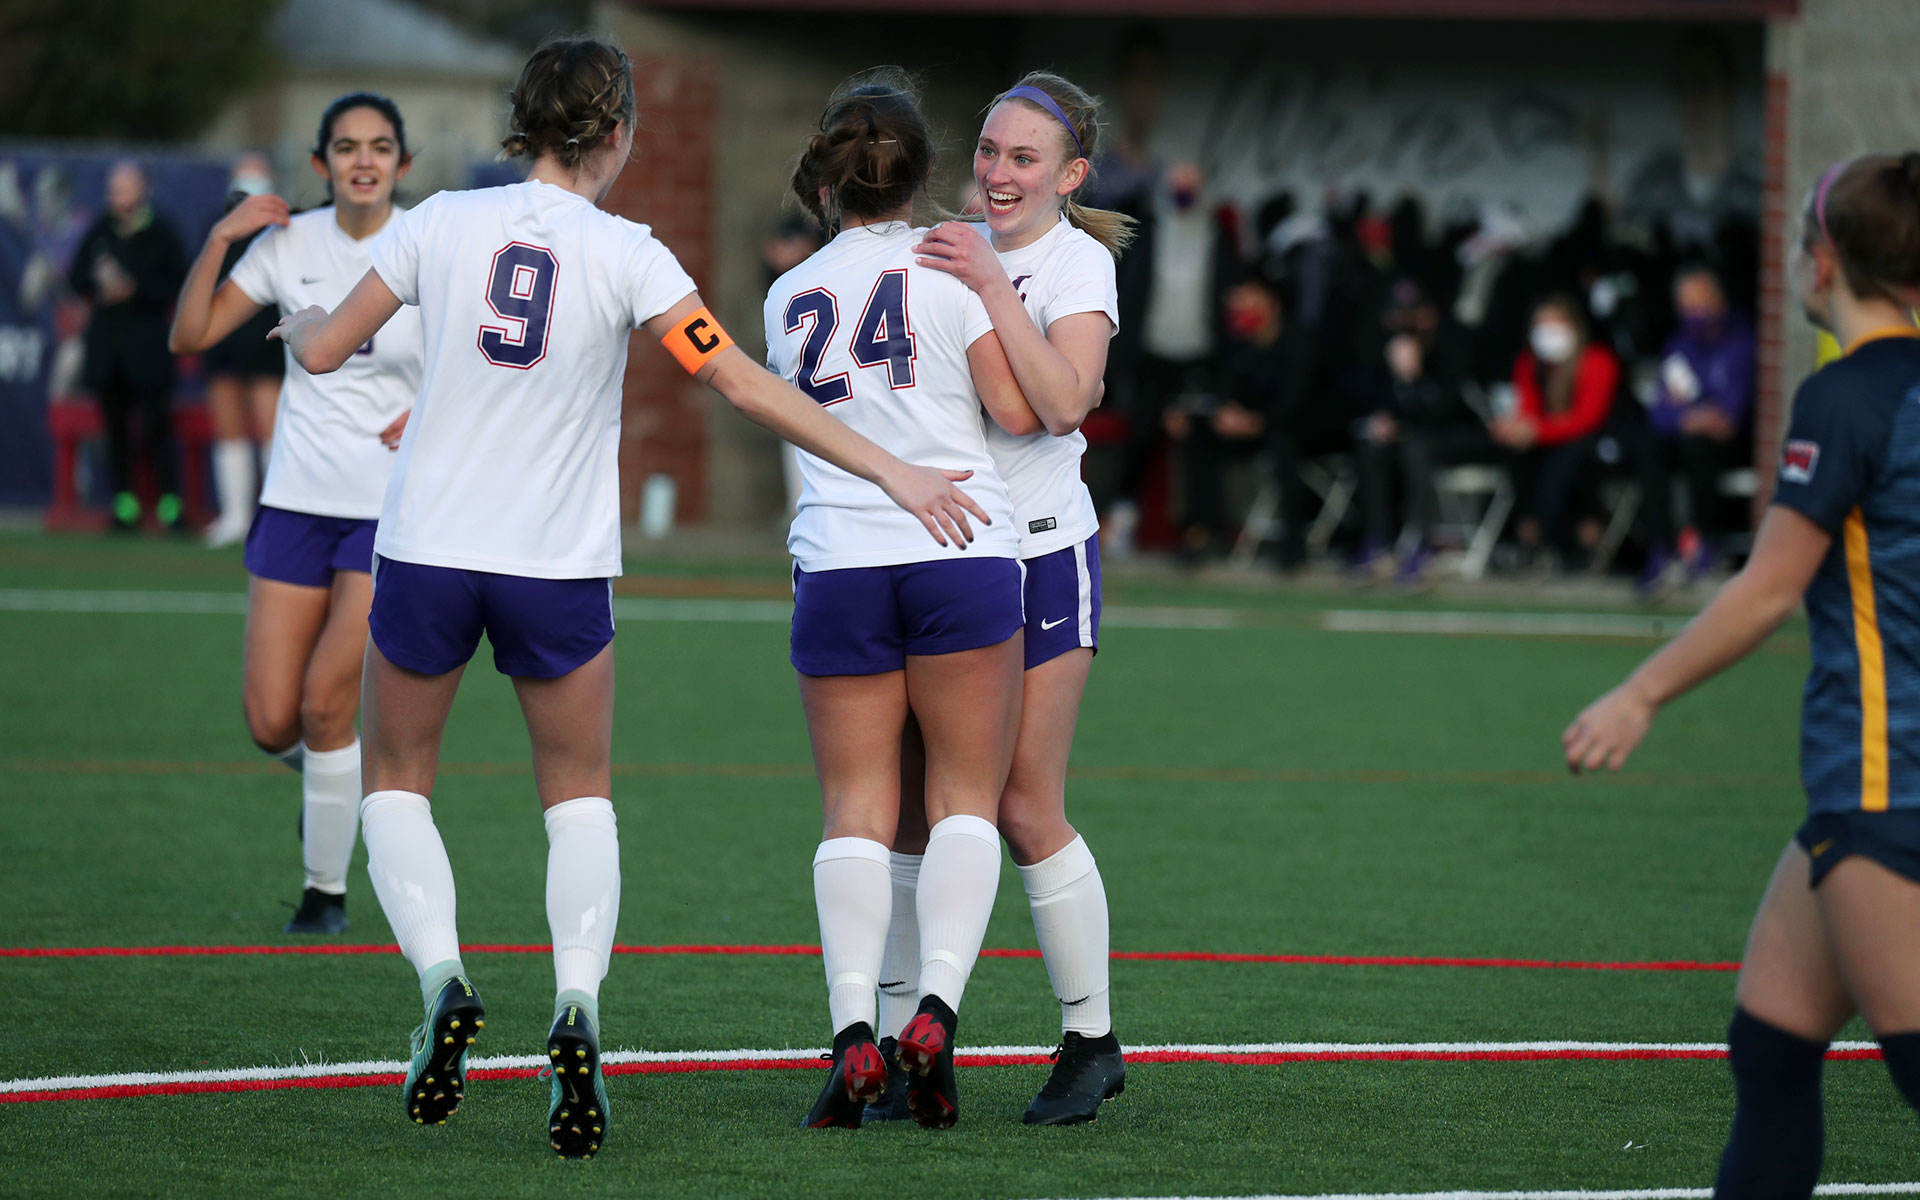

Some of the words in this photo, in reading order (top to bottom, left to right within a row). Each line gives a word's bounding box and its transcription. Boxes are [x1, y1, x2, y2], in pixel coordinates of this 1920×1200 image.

[477, 240, 560, 371] 9
[683, 317, 721, 355] C
[782, 267, 918, 408] 24
